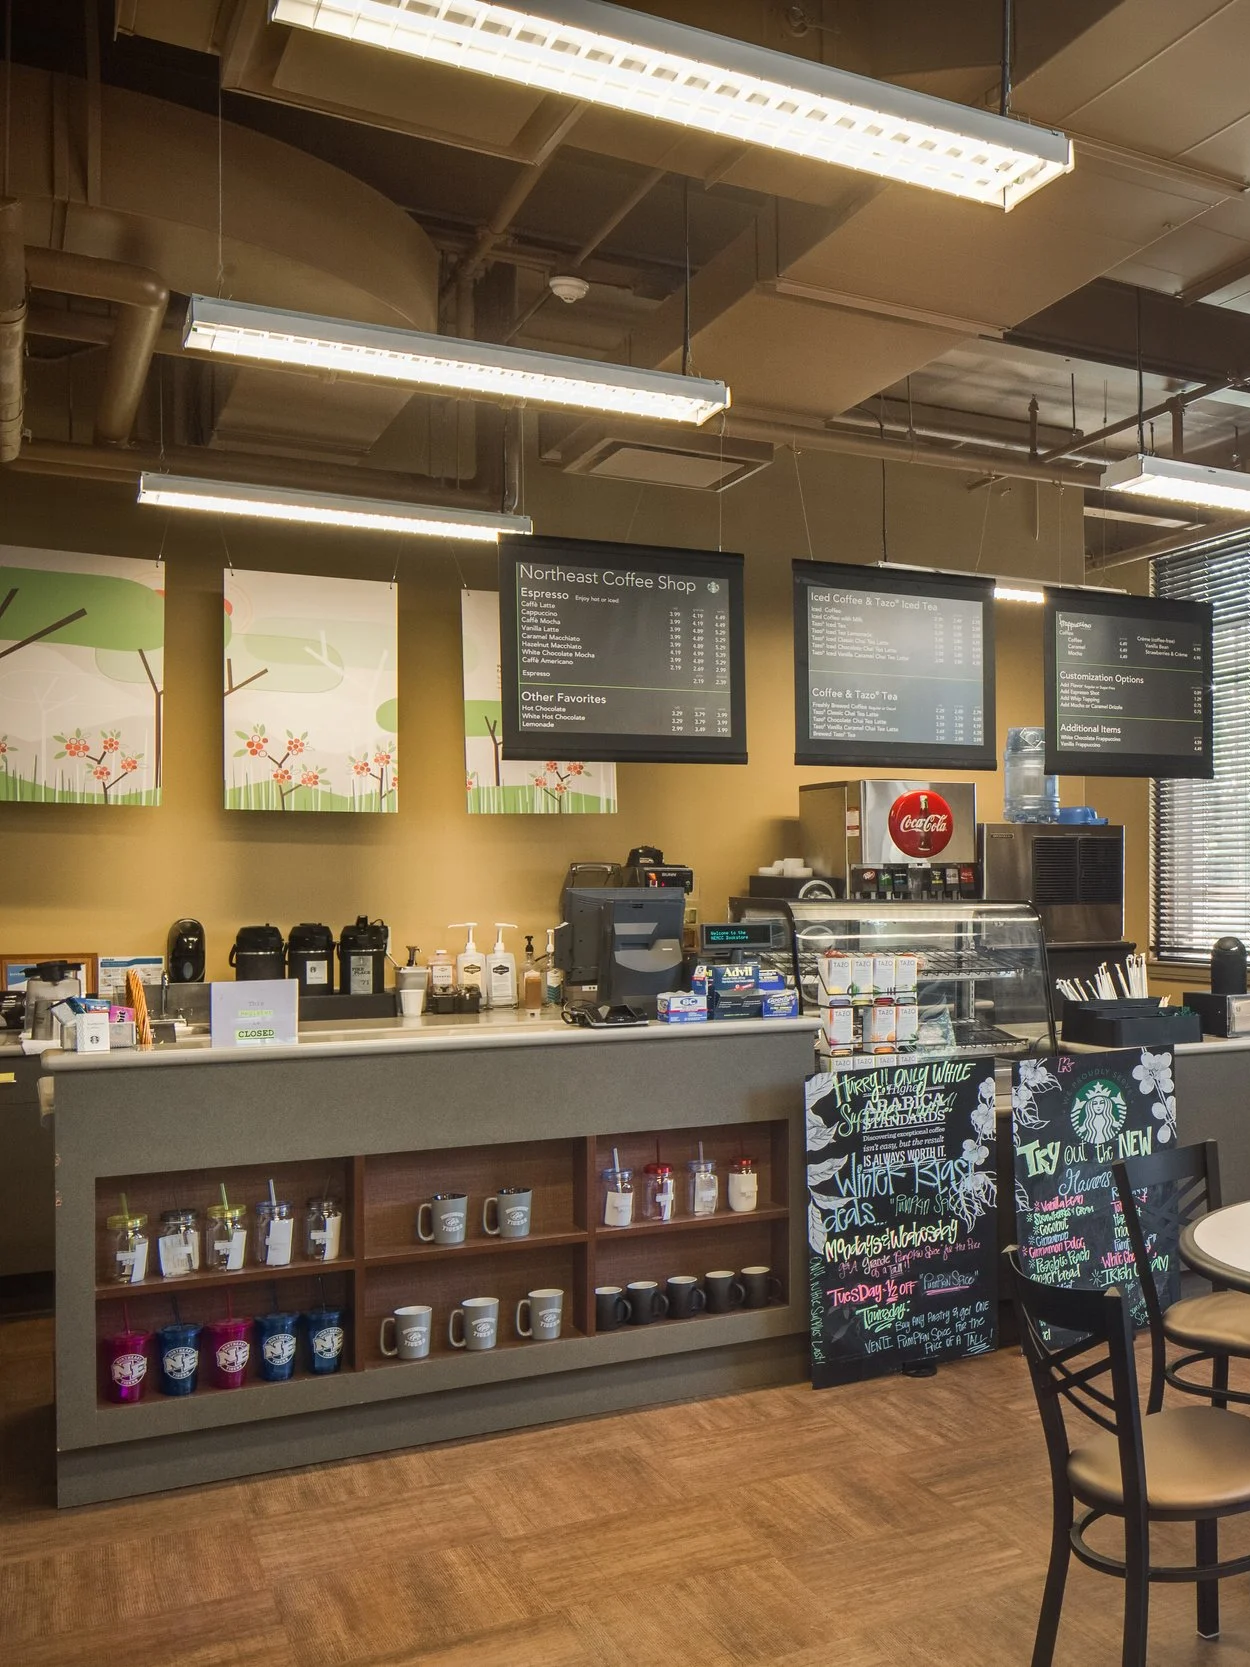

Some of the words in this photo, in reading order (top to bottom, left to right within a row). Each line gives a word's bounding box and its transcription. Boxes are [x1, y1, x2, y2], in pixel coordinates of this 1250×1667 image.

[520, 564, 598, 584] Northeast
[603, 571, 653, 588] Coffee
[658, 576, 696, 595] Shop
[521, 588, 569, 600] Espresso
[811, 592, 829, 602] Iced
[833, 594, 862, 605] Coffee
[866, 597, 872, 606] &
[902, 600, 919, 609] Iced
[922, 601, 937, 611] Tea
[521, 609, 558, 617] Cappuccino
[1060, 671, 1113, 682] Customization
[1115, 674, 1144, 685] Options
[522, 692, 553, 702] Other
[558, 693, 606, 704] Favorites
[812, 687, 842, 698] Coffee
[846, 690, 852, 698] &
[882, 691, 897, 700] Tea
[1060, 724, 1099, 733] Additional
[1101, 725, 1121, 734] Items
[724, 967, 753, 976] Advil
[863, 1132, 896, 1142] Discovering
[897, 1128, 928, 1139] exceptional
[863, 1143, 878, 1152] isn't
[879, 1143, 898, 1152] easy,
[924, 1136, 944, 1144] result
[1095, 1144, 1113, 1164] the
[1118, 1126, 1152, 1158] NEW
[863, 1154, 871, 1166] IS
[874, 1150, 905, 1165] ALWAYS
[908, 1148, 935, 1162] WORTH
[937, 1146, 946, 1157] IT.
[899, 1281, 918, 1295] OFF
[976, 1301, 990, 1313] ONE
[313, 1331, 344, 1354] NE
[956, 1335, 961, 1345] A
[217, 1344, 250, 1369] NE
[264, 1337, 296, 1362] NE
[112, 1358, 147, 1379] NE
[163, 1351, 198, 1376] NE
